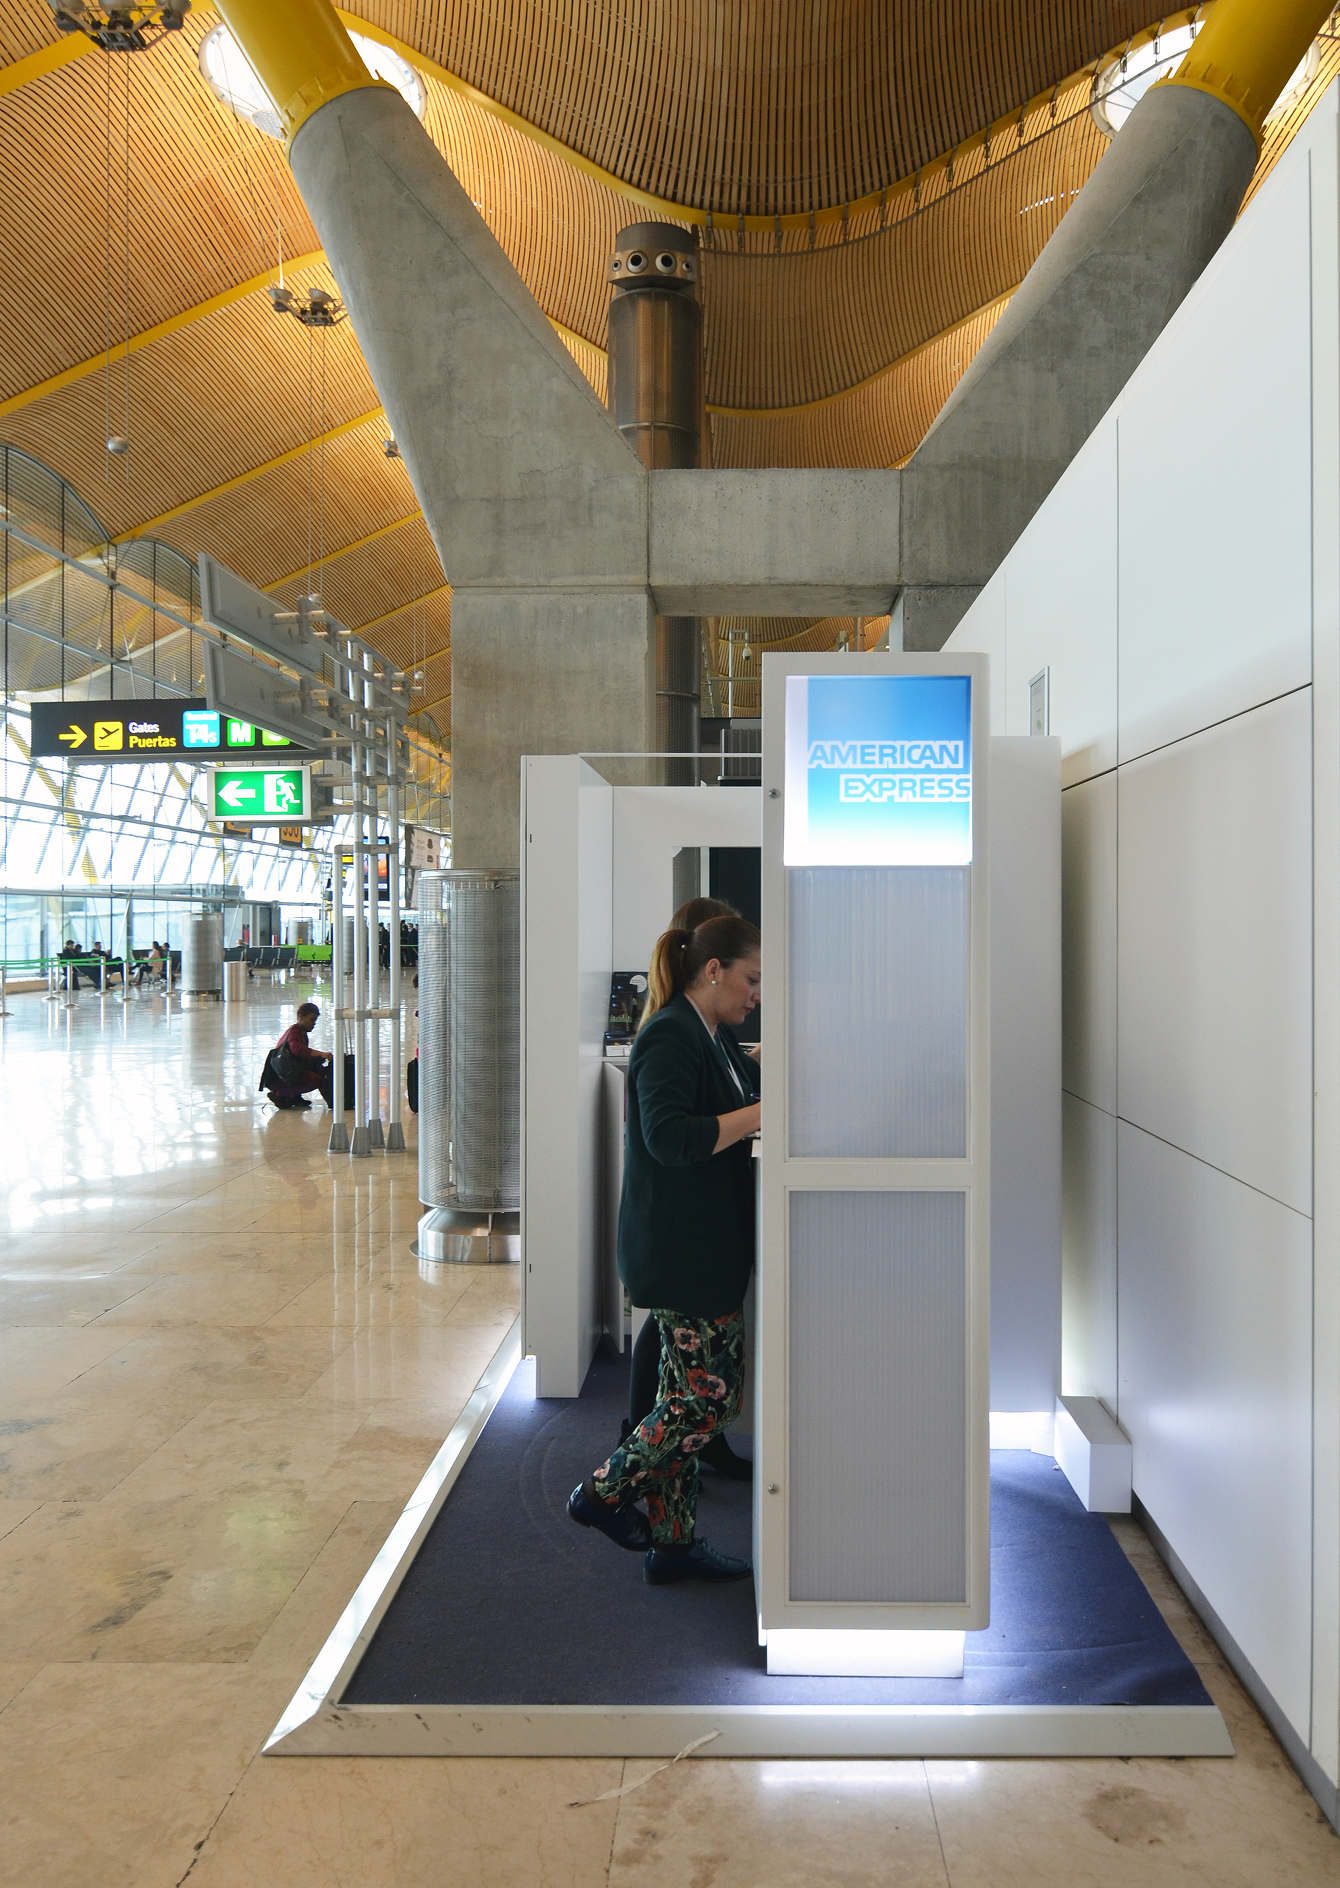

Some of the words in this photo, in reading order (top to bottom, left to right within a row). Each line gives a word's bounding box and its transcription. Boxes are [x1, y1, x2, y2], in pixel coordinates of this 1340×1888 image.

[128, 721, 160, 733] Gates
[128, 735, 177, 748] Puertas
[807, 742, 962, 767] AMERICAN
[841, 776, 971, 800] EXPRESS
